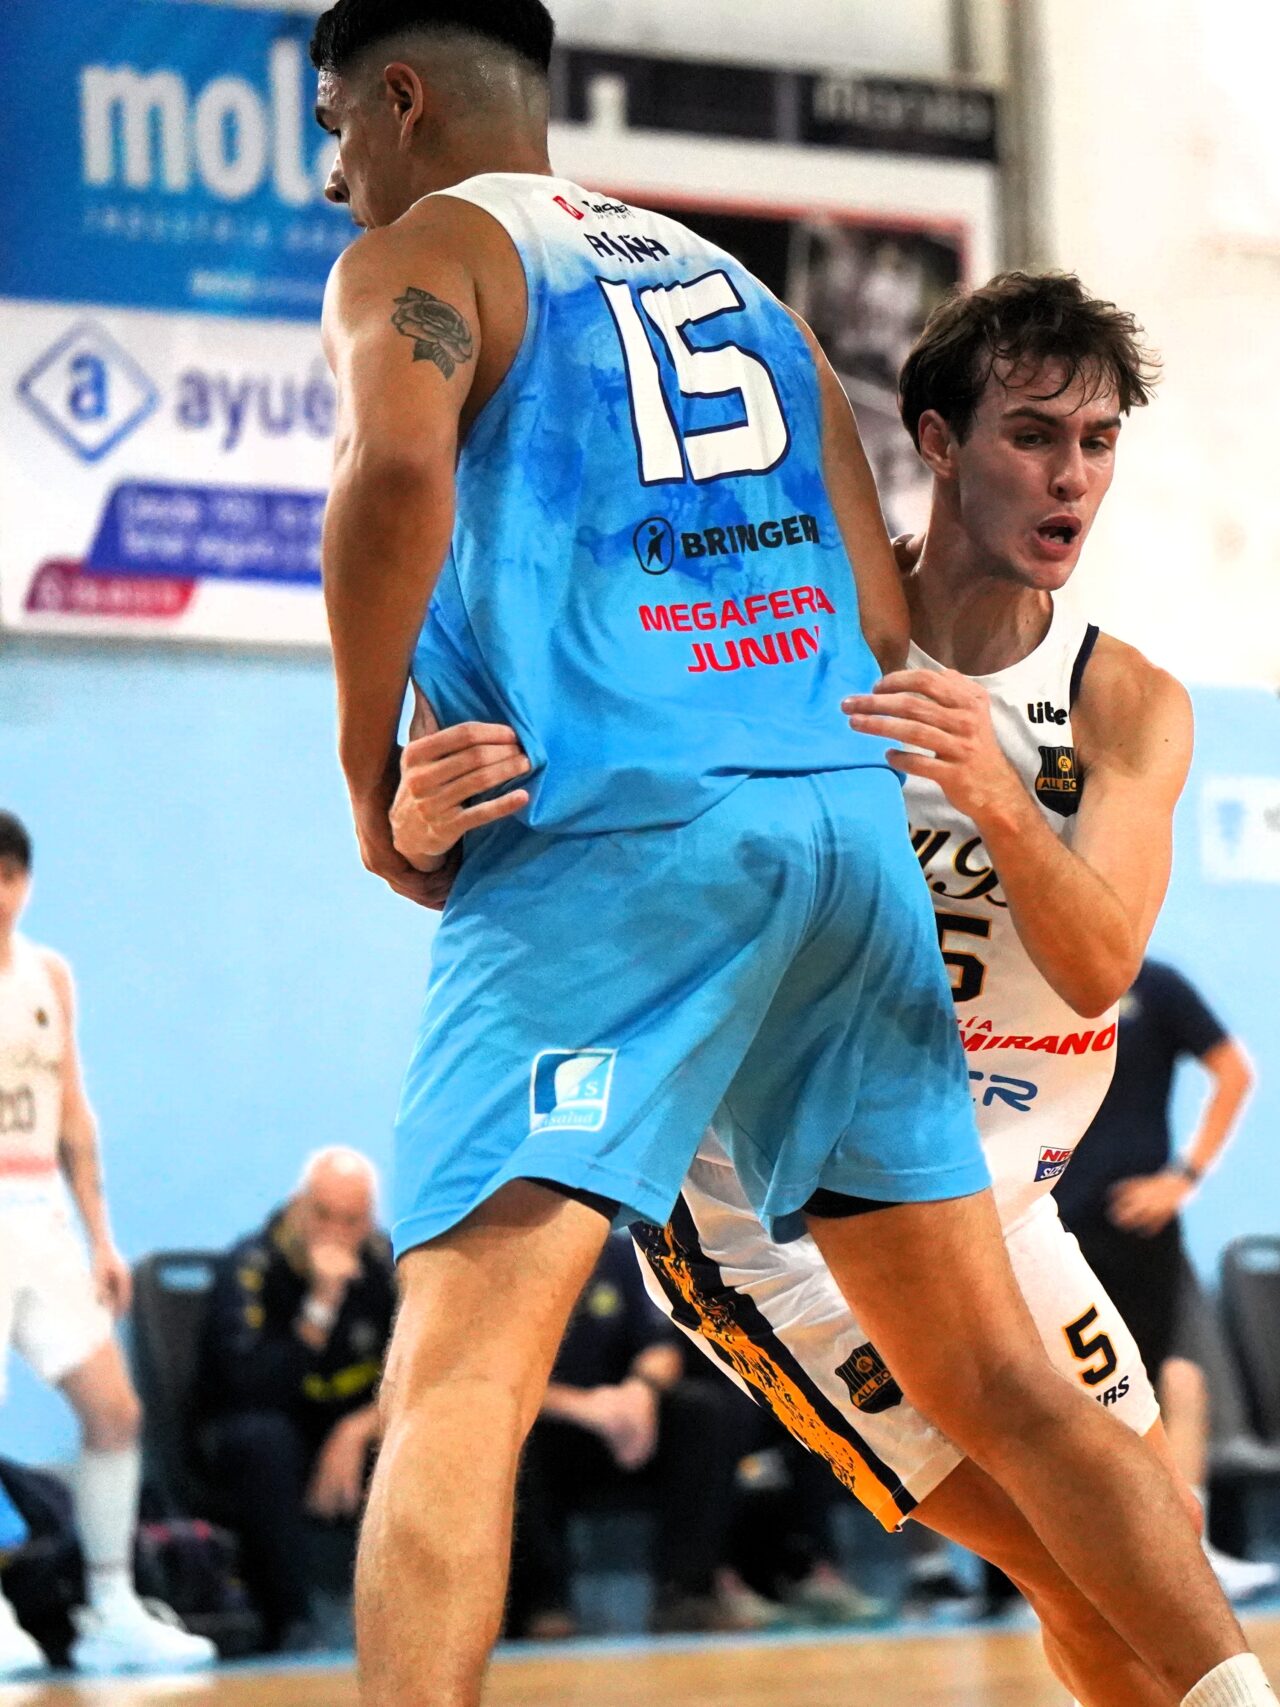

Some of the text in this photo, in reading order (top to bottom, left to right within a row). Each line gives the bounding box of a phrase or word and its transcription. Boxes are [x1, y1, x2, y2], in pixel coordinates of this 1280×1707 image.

[595, 269, 791, 487] 15
[681, 514, 820, 559] BRINGER
[638, 586, 836, 632] MEGAFERA
[1027, 701, 1068, 726] lite
[1041, 779, 1060, 790] ALL
[933, 911, 992, 1004] 5
[1061, 1302, 1118, 1388] 5
[857, 1382, 877, 1403] ALL
